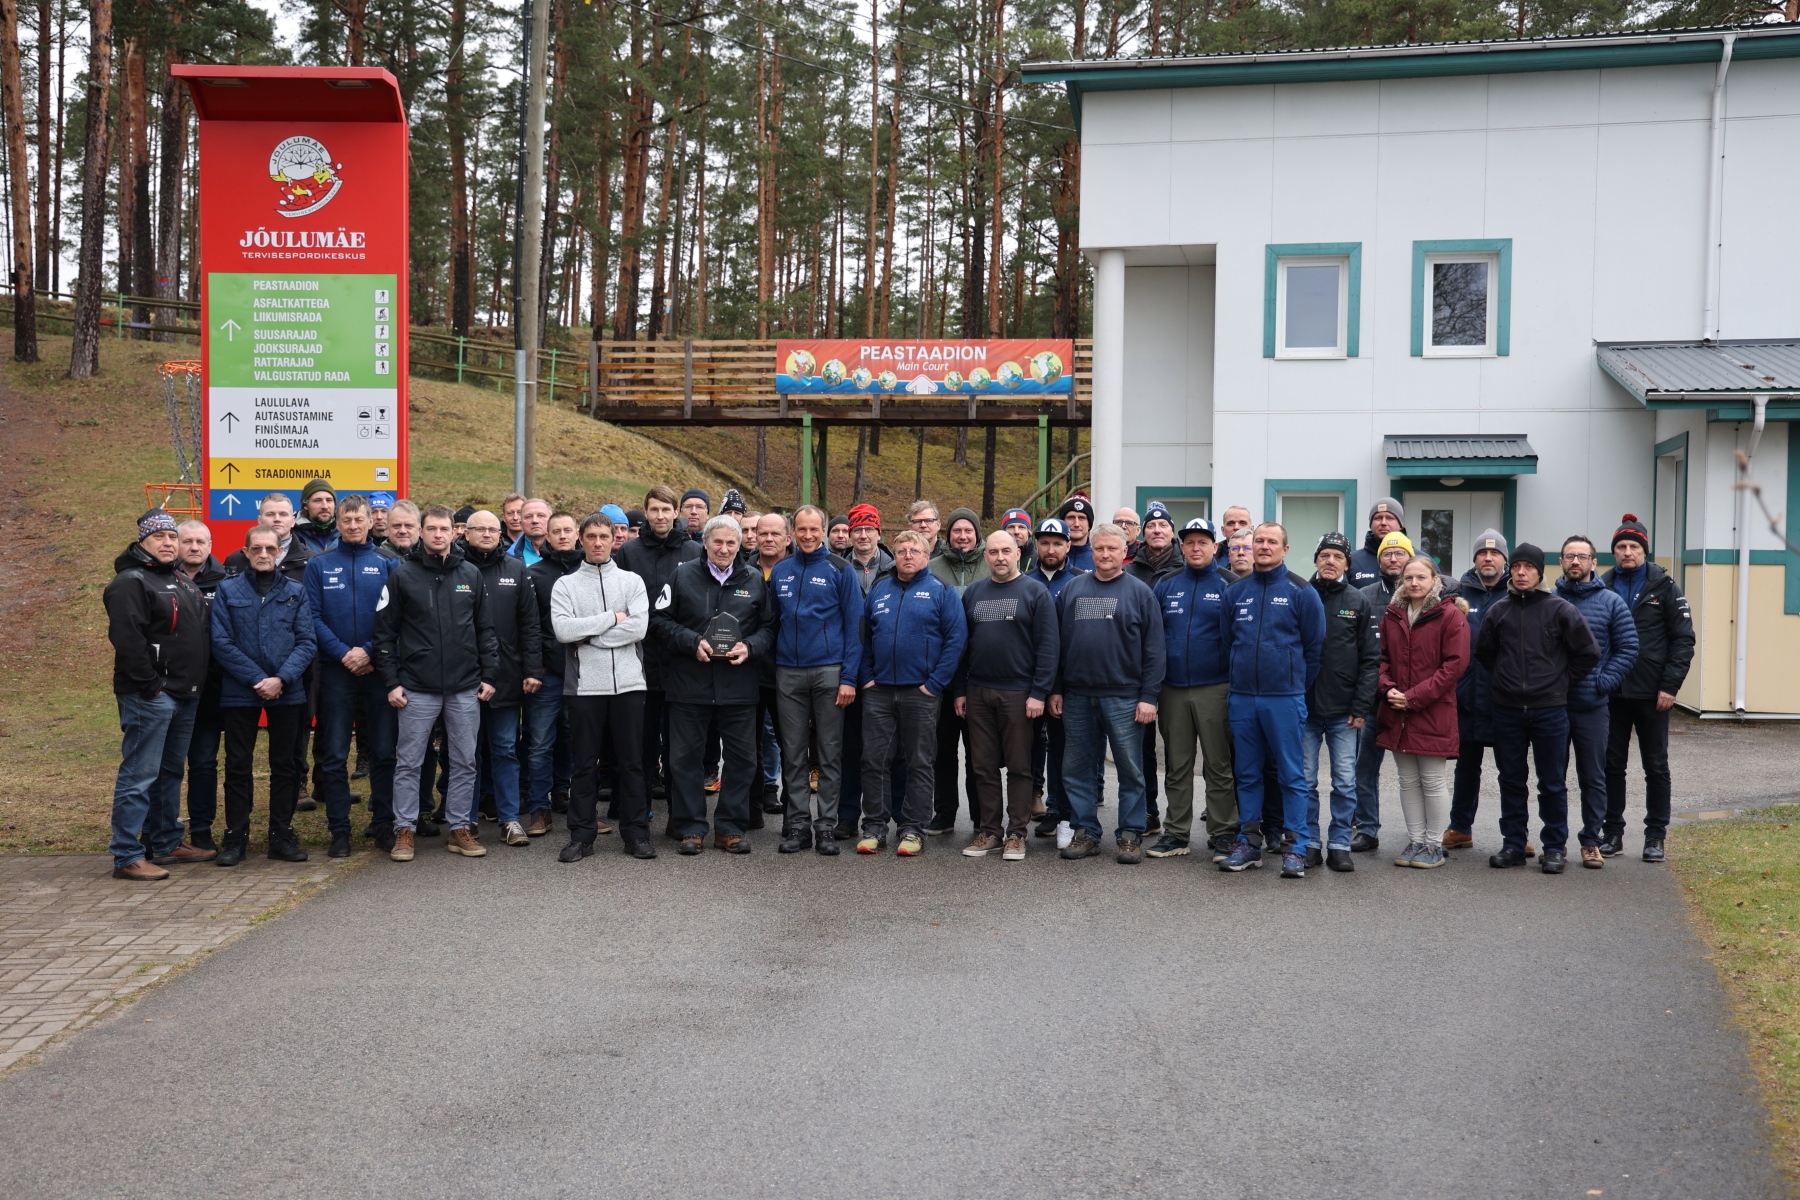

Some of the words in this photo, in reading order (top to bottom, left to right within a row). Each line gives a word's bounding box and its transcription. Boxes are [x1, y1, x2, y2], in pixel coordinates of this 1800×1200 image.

[239, 226, 366, 248] JÕULUMÄE
[242, 252, 366, 260] TERVISESPORDIKESKUS
[253, 280, 319, 291] PEASTAADION
[253, 298, 330, 309] ASFALTKATTEGA
[253, 312, 322, 323] LIIKUMISRADA
[253, 329, 318, 340] SUUSARAJAD
[253, 343, 323, 354] JOOKSURAJAD
[860, 345, 987, 361] PEASTAADION
[254, 357, 314, 368] RATTARAJAD
[896, 361, 920, 371] Main
[922, 361, 949, 371] Court
[254, 371, 322, 381] VALGUSTATUD
[324, 371, 350, 382] RADA
[255, 397, 310, 408] LAULULAVA
[254, 411, 334, 422] AUTASUSTAMINE
[255, 423, 309, 436] FINIŠIMAJA
[255, 438, 320, 449] HOOLDEMAJA
[255, 468, 332, 479] STAADIONIMAJA
